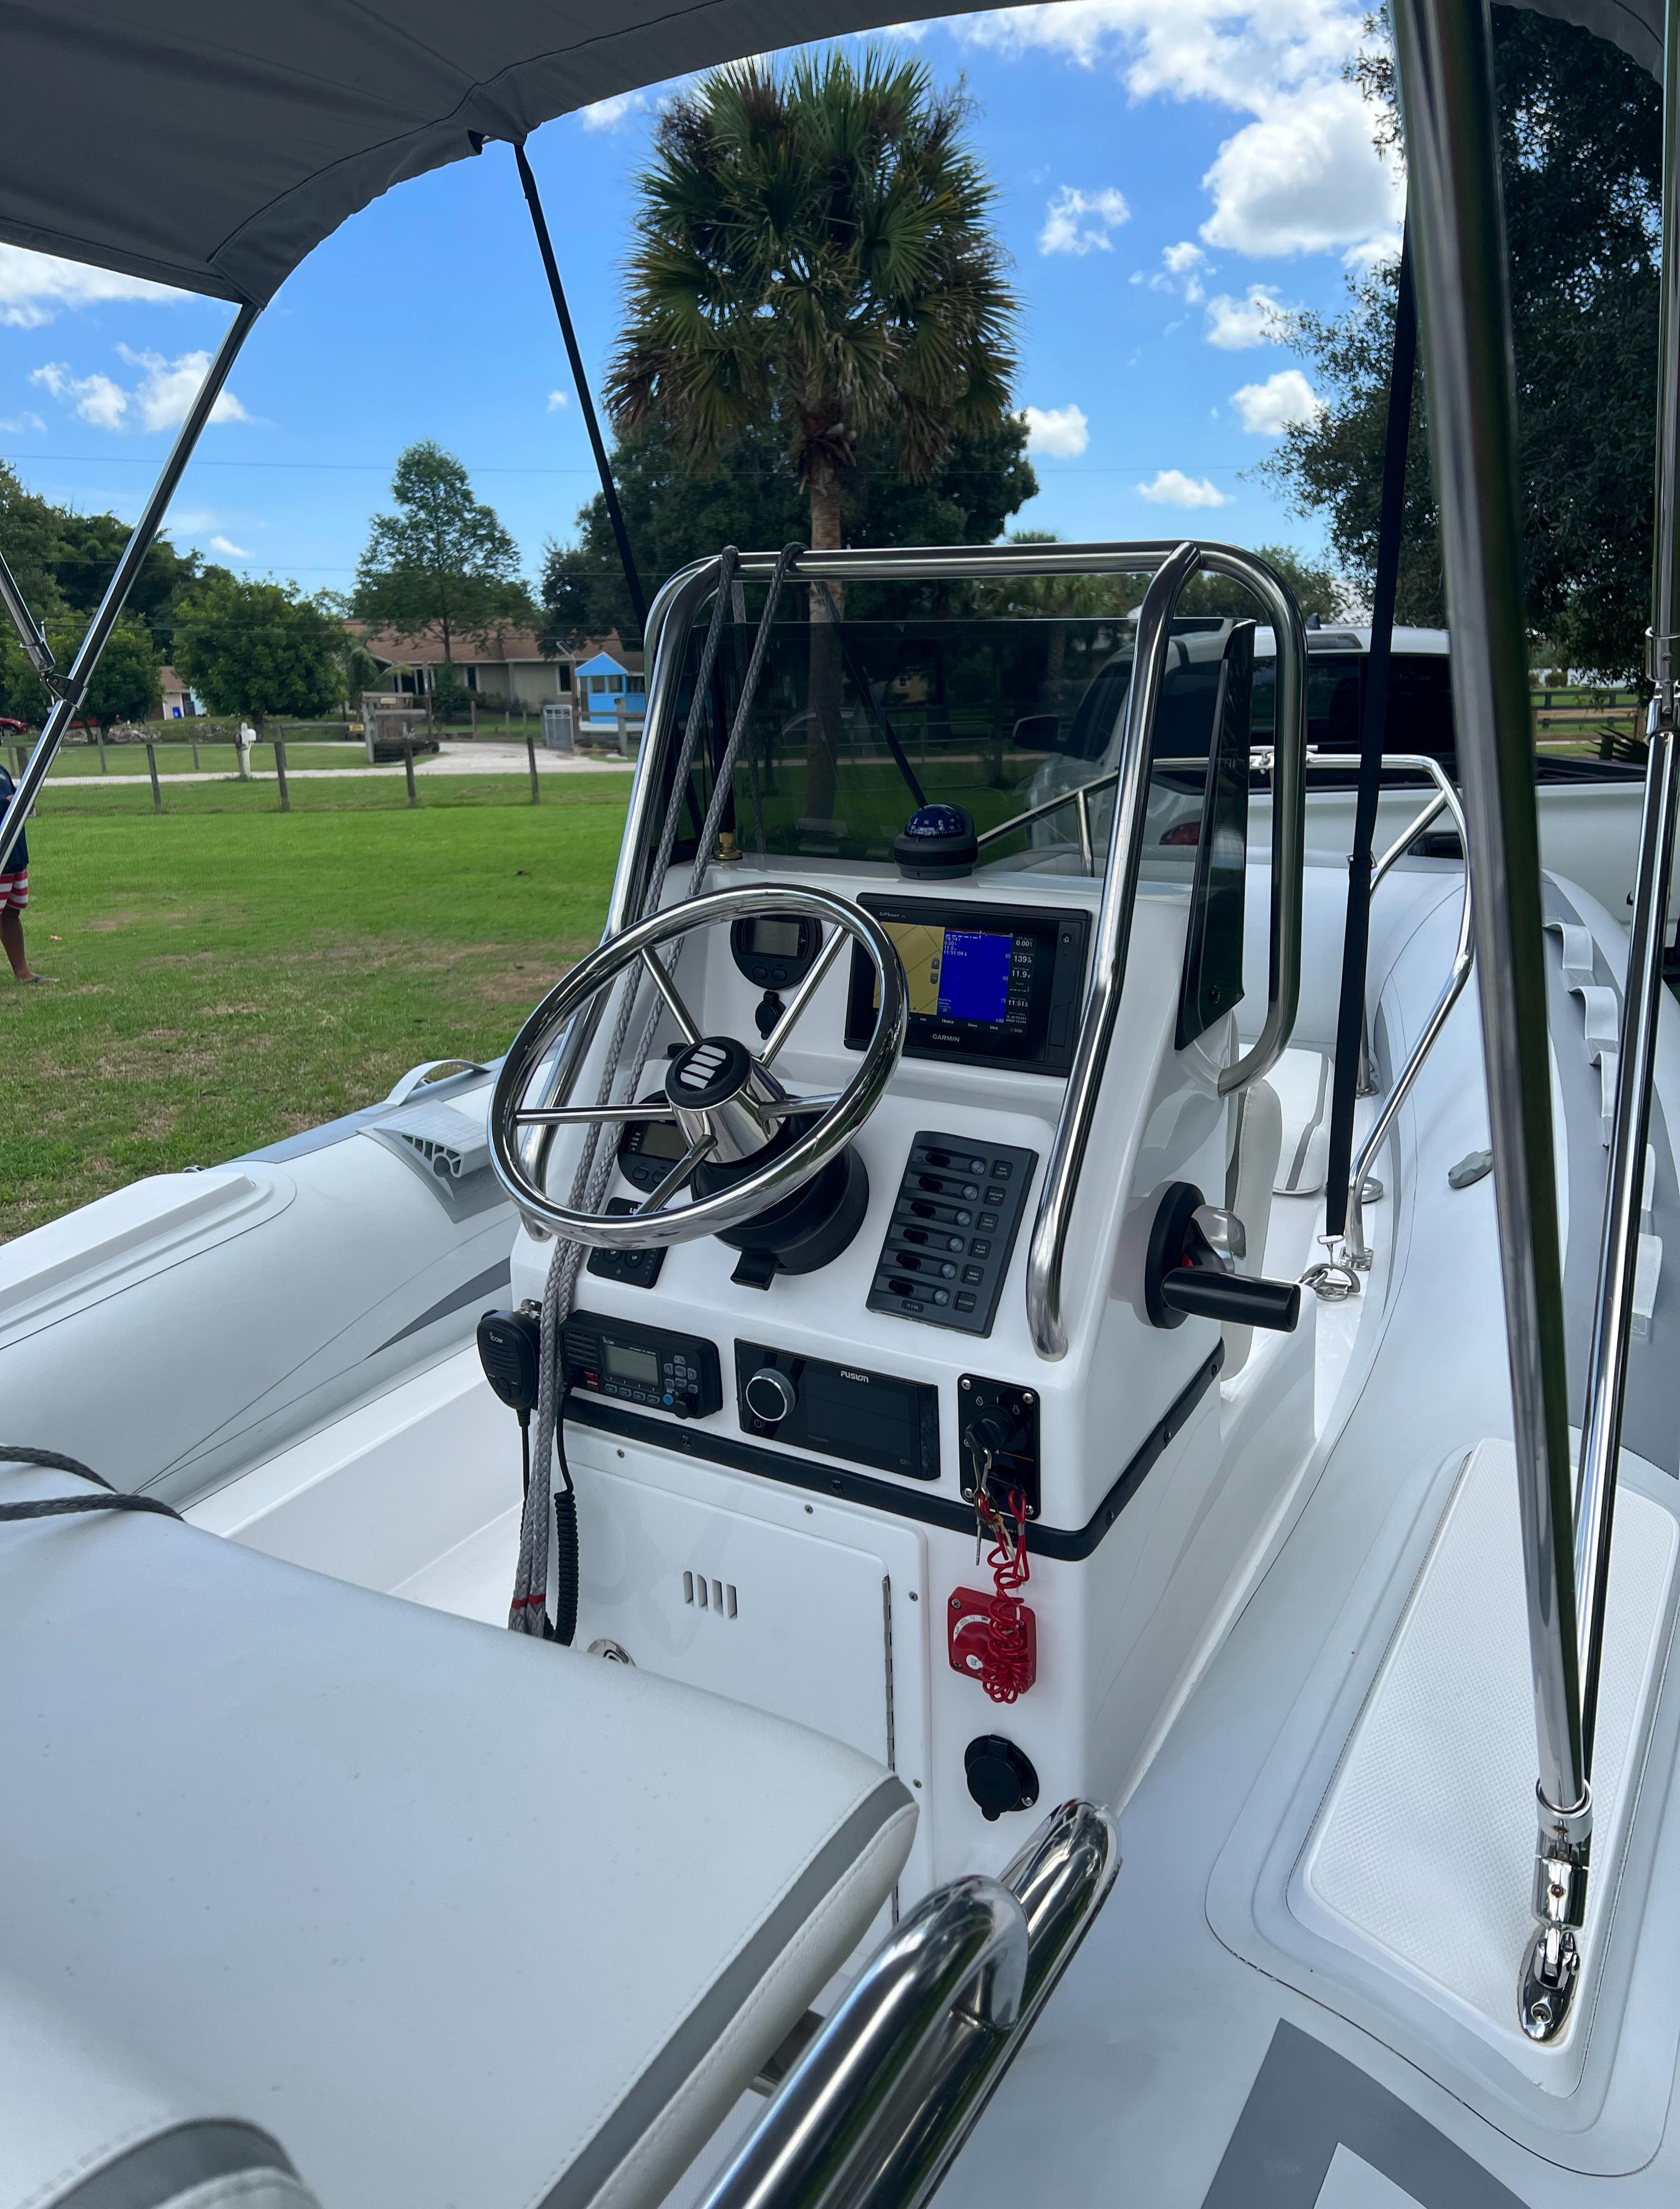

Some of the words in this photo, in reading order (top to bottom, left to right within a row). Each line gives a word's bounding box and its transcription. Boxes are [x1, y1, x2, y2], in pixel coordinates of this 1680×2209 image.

[1014, 954, 1027, 963] 139
[932, 1033, 960, 1042] GARMIN
[841, 1370, 869, 1383] FUSION
